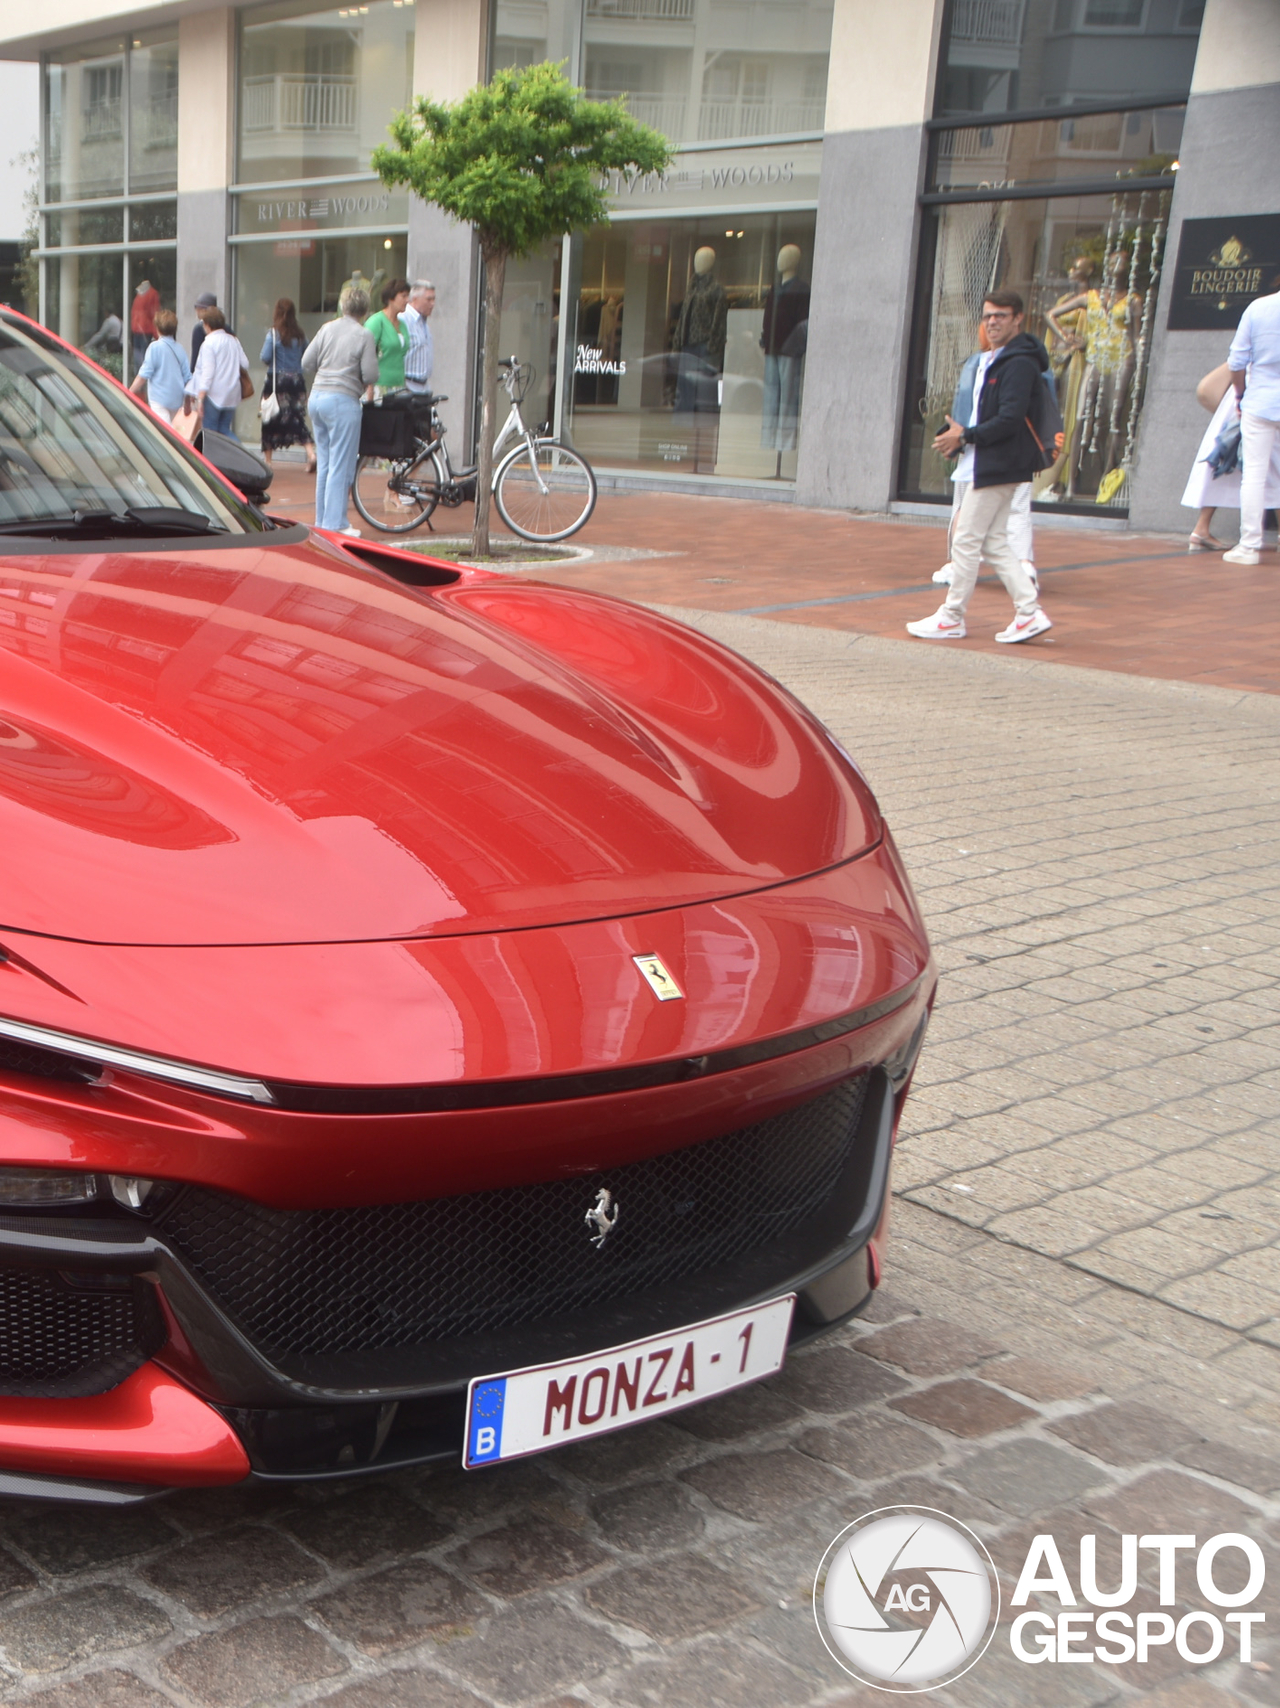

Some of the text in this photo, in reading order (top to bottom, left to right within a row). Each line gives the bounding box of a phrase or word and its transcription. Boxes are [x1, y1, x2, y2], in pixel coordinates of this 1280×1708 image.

[599, 161, 795, 196] RIVER WOODS
[257, 193, 389, 220] RIVER WOODS
[1193, 268, 1262, 283] BOUDOIR
[1191, 281, 1259, 294] LINGERIE
[576, 344, 602, 361] New
[574, 360, 626, 375] ARRIVALS
[543, 1341, 696, 1436] MONZA
[476, 1426, 496, 1455] B
